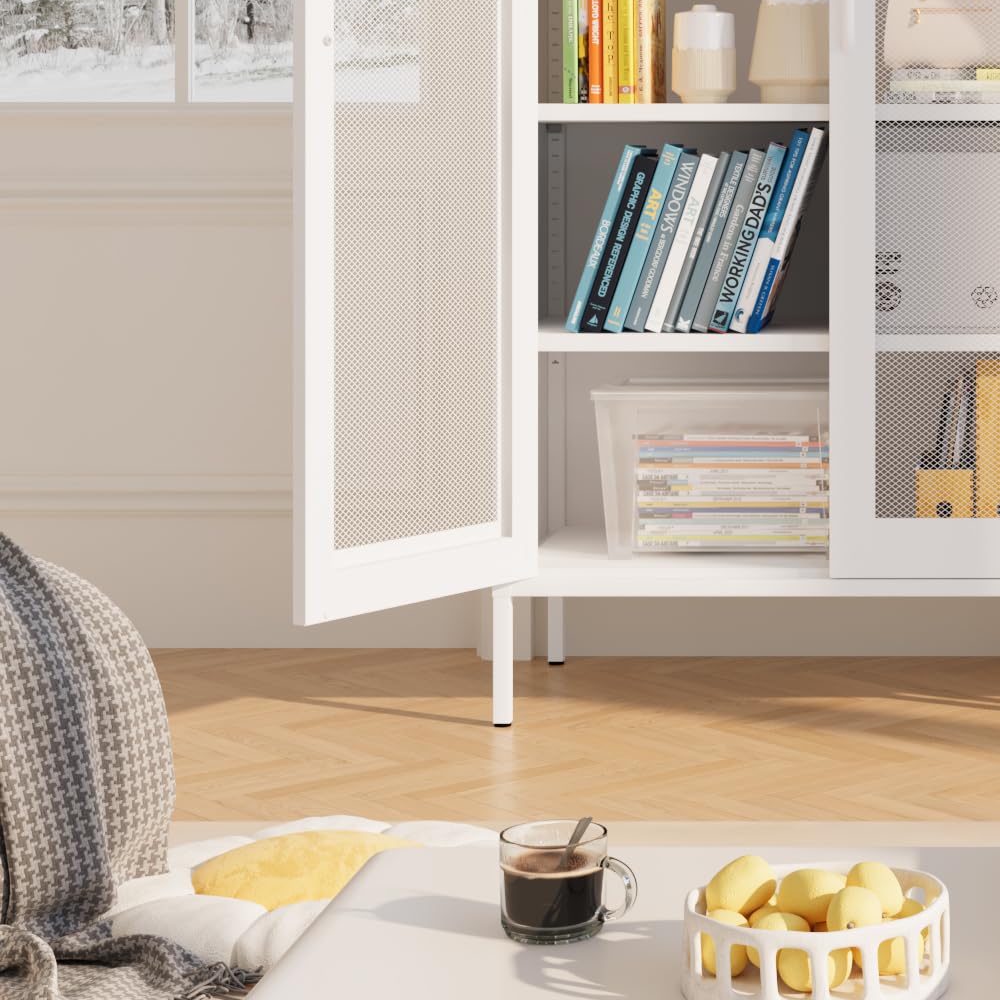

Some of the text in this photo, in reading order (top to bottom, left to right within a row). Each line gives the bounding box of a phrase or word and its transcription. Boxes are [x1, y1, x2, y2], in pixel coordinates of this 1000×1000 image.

[626, 170, 645, 210] GRAPHIC
[642, 187, 664, 221] ART
[658, 158, 694, 234] WINDOWS
[718, 185, 734, 218] DESIGNERS
[614, 209, 632, 242] DESIGN
[724, 203, 745, 241] Gardens
[586, 218, 611, 269] BORDEAUX
[717, 180, 773, 305] WORKING DAD'S
[721, 240, 732, 251] in
[597, 242, 622, 298] REFERENCED
[710, 251, 728, 282] France
